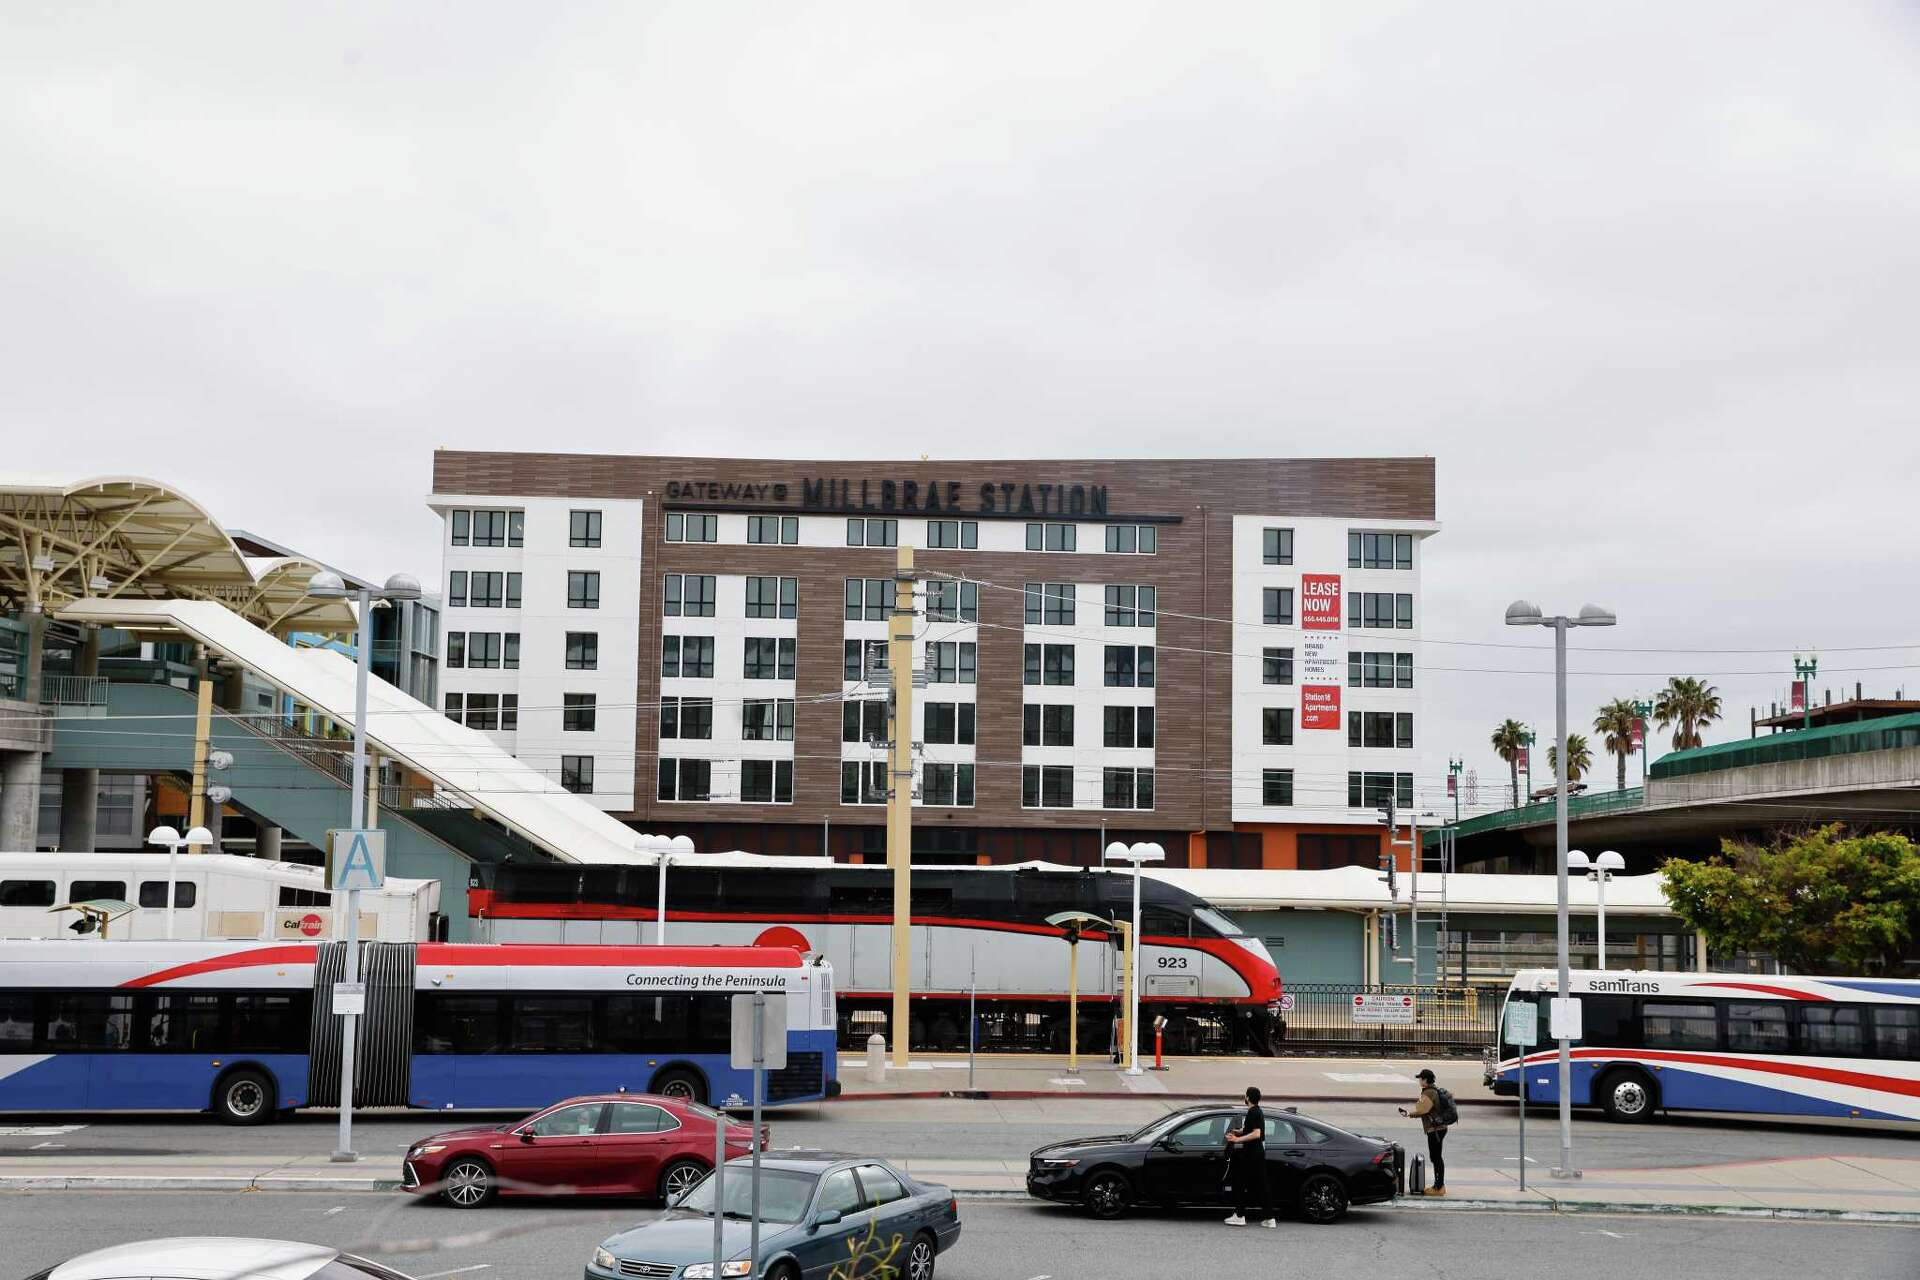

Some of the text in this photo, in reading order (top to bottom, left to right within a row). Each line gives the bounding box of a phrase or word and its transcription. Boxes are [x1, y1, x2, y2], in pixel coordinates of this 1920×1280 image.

[666, 481, 768, 500] GATEWAY
[803, 478, 961, 512] MILLBRAE
[979, 482, 1107, 515] STATION
[1303, 582, 1339, 596] LEASE
[1303, 598, 1331, 612] NOW
[338, 832, 380, 888] A
[1158, 957, 1187, 968] 923
[626, 973, 786, 988] Connecting the Peninsula
[1589, 979, 1660, 993] samTrans
